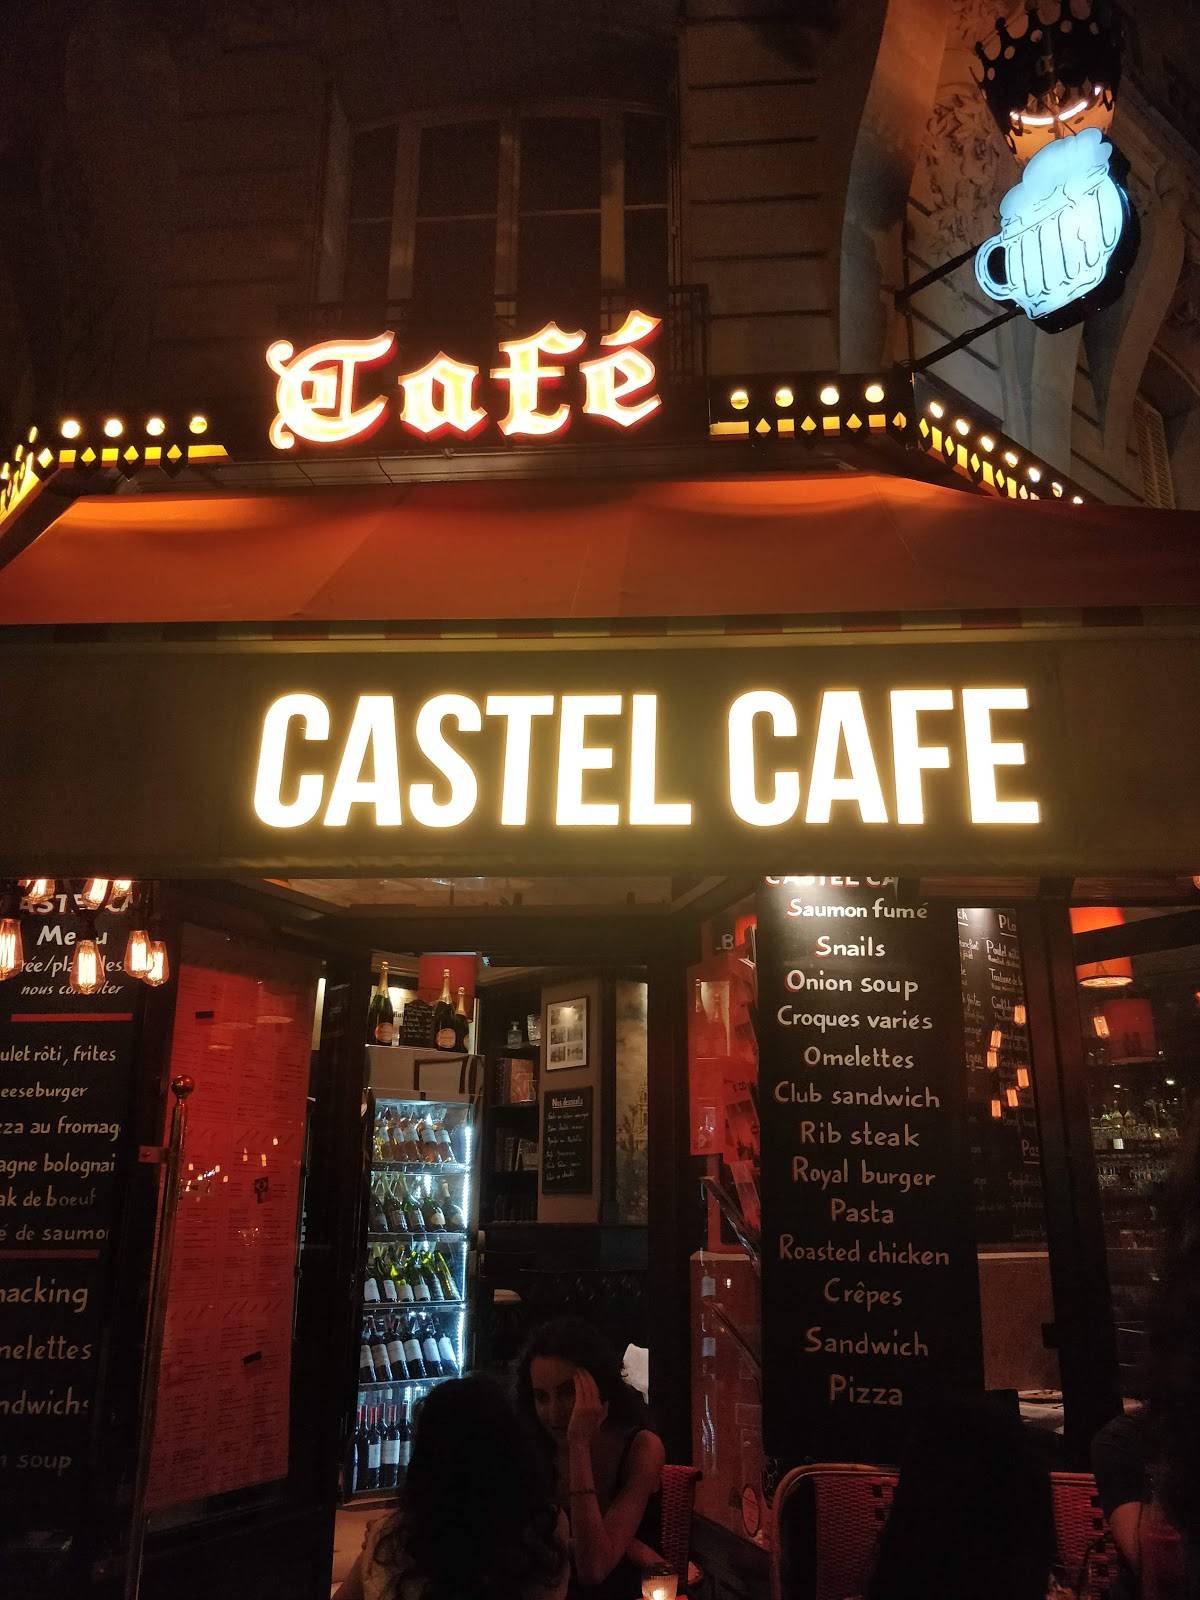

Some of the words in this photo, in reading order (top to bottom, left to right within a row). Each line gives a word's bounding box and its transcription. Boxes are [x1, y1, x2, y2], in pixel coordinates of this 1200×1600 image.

[252, 692, 692, 828] CASTEL
[726, 688, 1041, 827] CAFE
[787, 898, 868, 918] Saumon
[872, 898, 928, 919] fumé
[36, 925, 108, 946] Meu
[815, 935, 886, 958] Snails
[20, 983, 54, 996] nous
[787, 970, 853, 993] Onion
[860, 977, 920, 1001] soup
[777, 1005, 860, 1034] Croques
[867, 1010, 933, 1031] variés
[73, 1044, 117, 1062] frites
[804, 1044, 915, 1070] Omelettes
[0, 1081, 89, 1103] eeseburger
[774, 1080, 823, 1104] Club
[831, 1086, 941, 1109] sandwich
[30, 1122, 52, 1134] au
[801, 1120, 842, 1144] Rib
[849, 1123, 920, 1148] steak
[791, 1155, 849, 1191] Royal
[861, 1158, 936, 1193] burger
[22, 1189, 42, 1208] de
[831, 1197, 895, 1225] Pasta
[15, 1223, 36, 1241] de
[779, 1233, 860, 1263] Roasted
[867, 1241, 950, 1266] chicken
[824, 1277, 903, 1313] Crêpes
[804, 1326, 929, 1357] Sandwich
[829, 1373, 904, 1407] Pizza
[16, 1453, 74, 1479] soup
